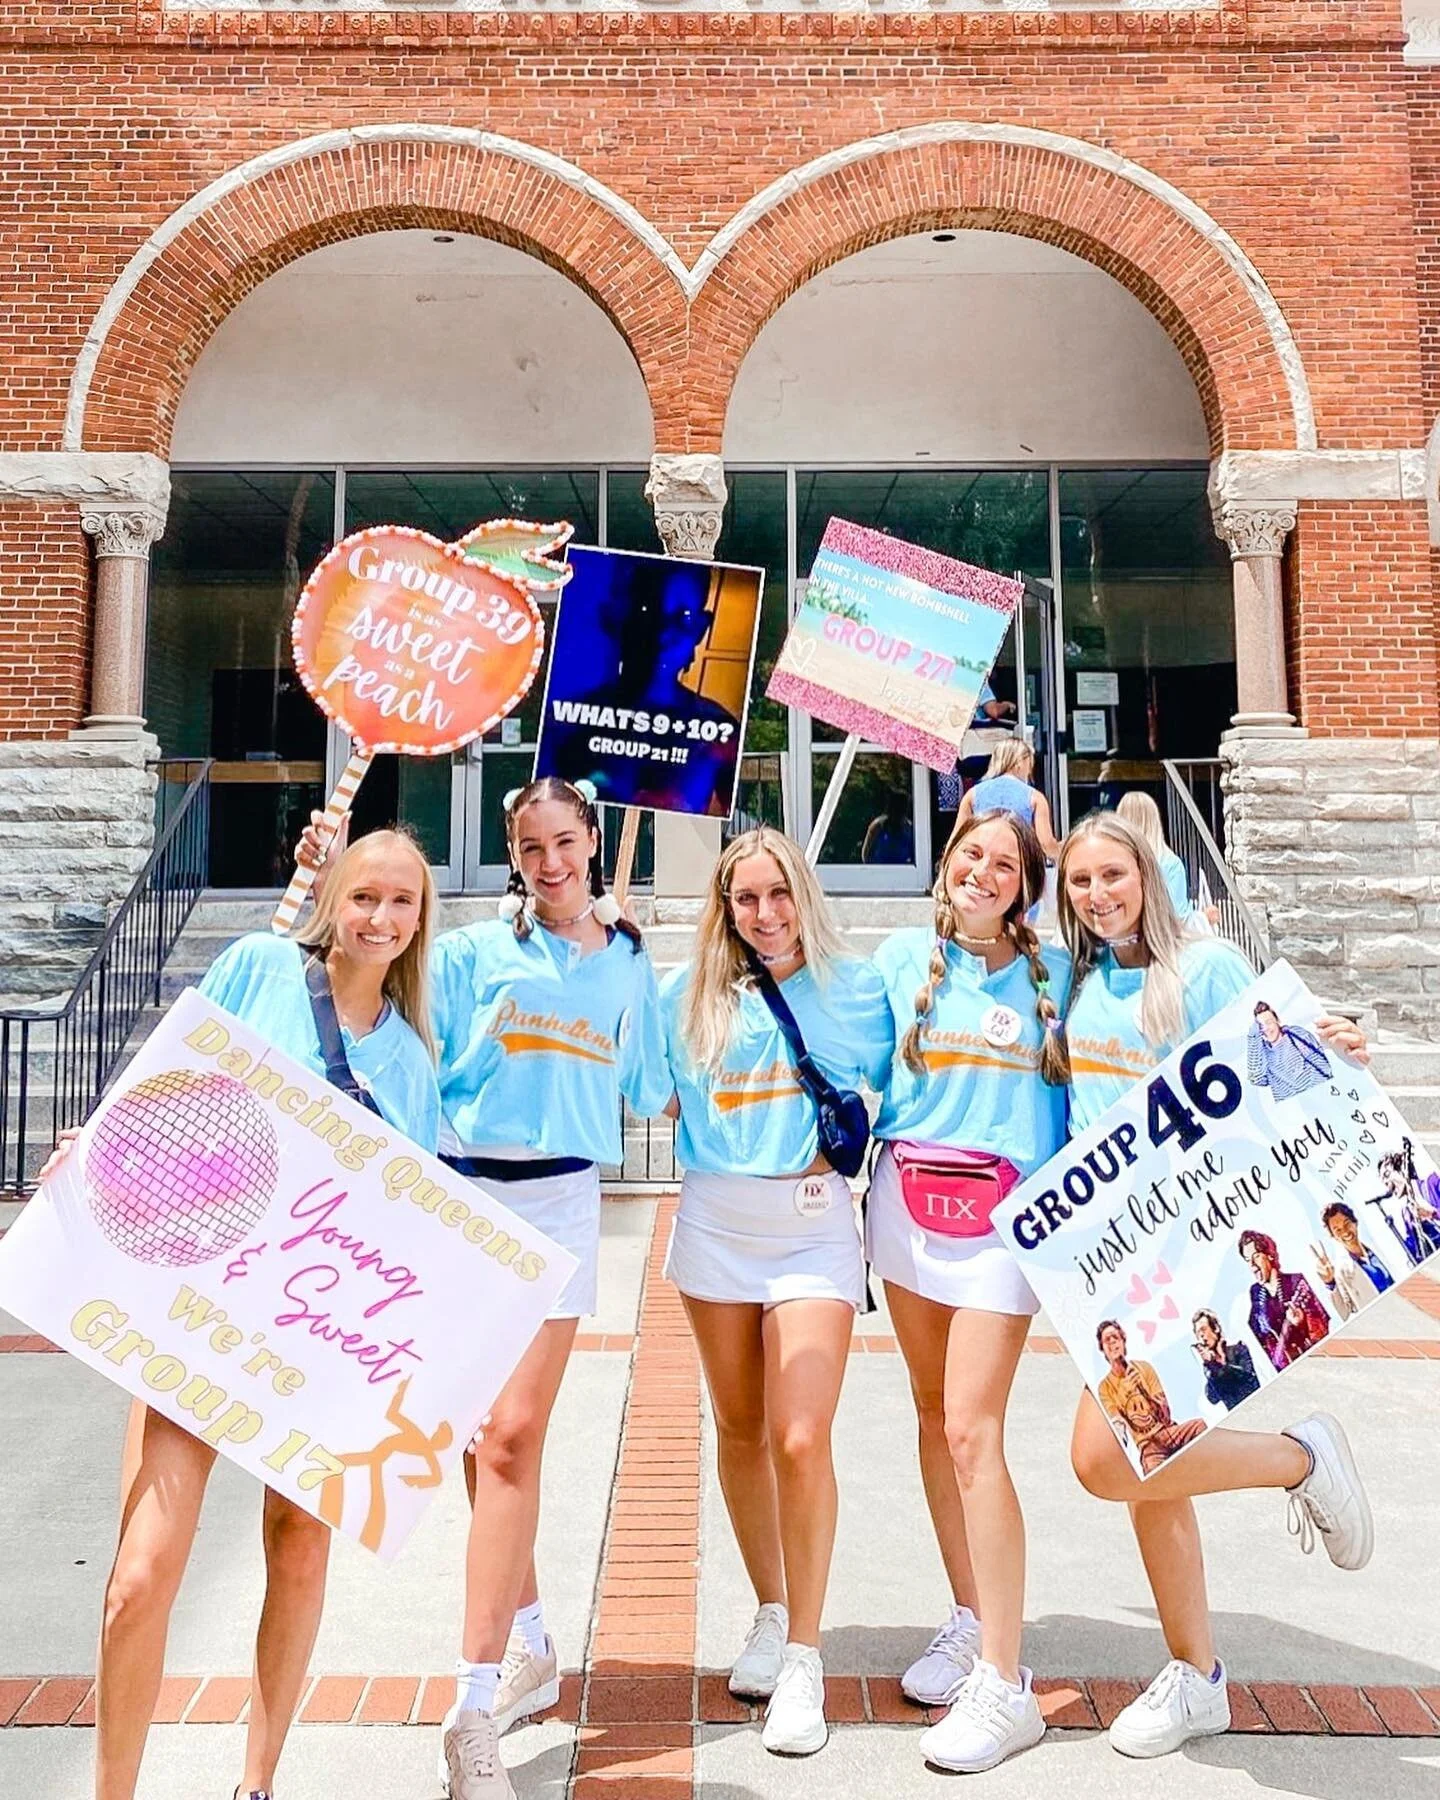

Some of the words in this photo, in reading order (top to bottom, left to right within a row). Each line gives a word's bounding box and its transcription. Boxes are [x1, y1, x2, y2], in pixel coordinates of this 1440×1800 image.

[348, 546, 477, 619] Group
[476, 594, 531, 645] 39
[823, 612, 913, 665] GROUP
[851, 571, 860, 583] A
[862, 575, 885, 590] HOT
[885, 583, 910, 600] NEW
[322, 654, 455, 731] peach
[344, 605, 485, 684] sweet
[384, 660, 402, 673] as
[403, 668, 416, 680] a
[588, 736, 650, 759] GROUP
[181, 1017, 388, 1172] Dancing
[382, 1156, 547, 1281] Queens
[1012, 1122, 1139, 1250] GROUP
[1146, 1040, 1243, 1153] 46
[1190, 1165, 1271, 1242] adore
[1270, 1117, 1336, 1182] you
[280, 1178, 424, 1318] Young
[1073, 1213, 1137, 1296] just
[1127, 1177, 1181, 1235] let
[1176, 1150, 1224, 1200] me
[167, 1283, 305, 1396] We're
[223, 1242, 268, 1285] &
[274, 1264, 423, 1384] Sweet
[70, 1299, 264, 1445] Group
[260, 1428, 346, 1491] 17
